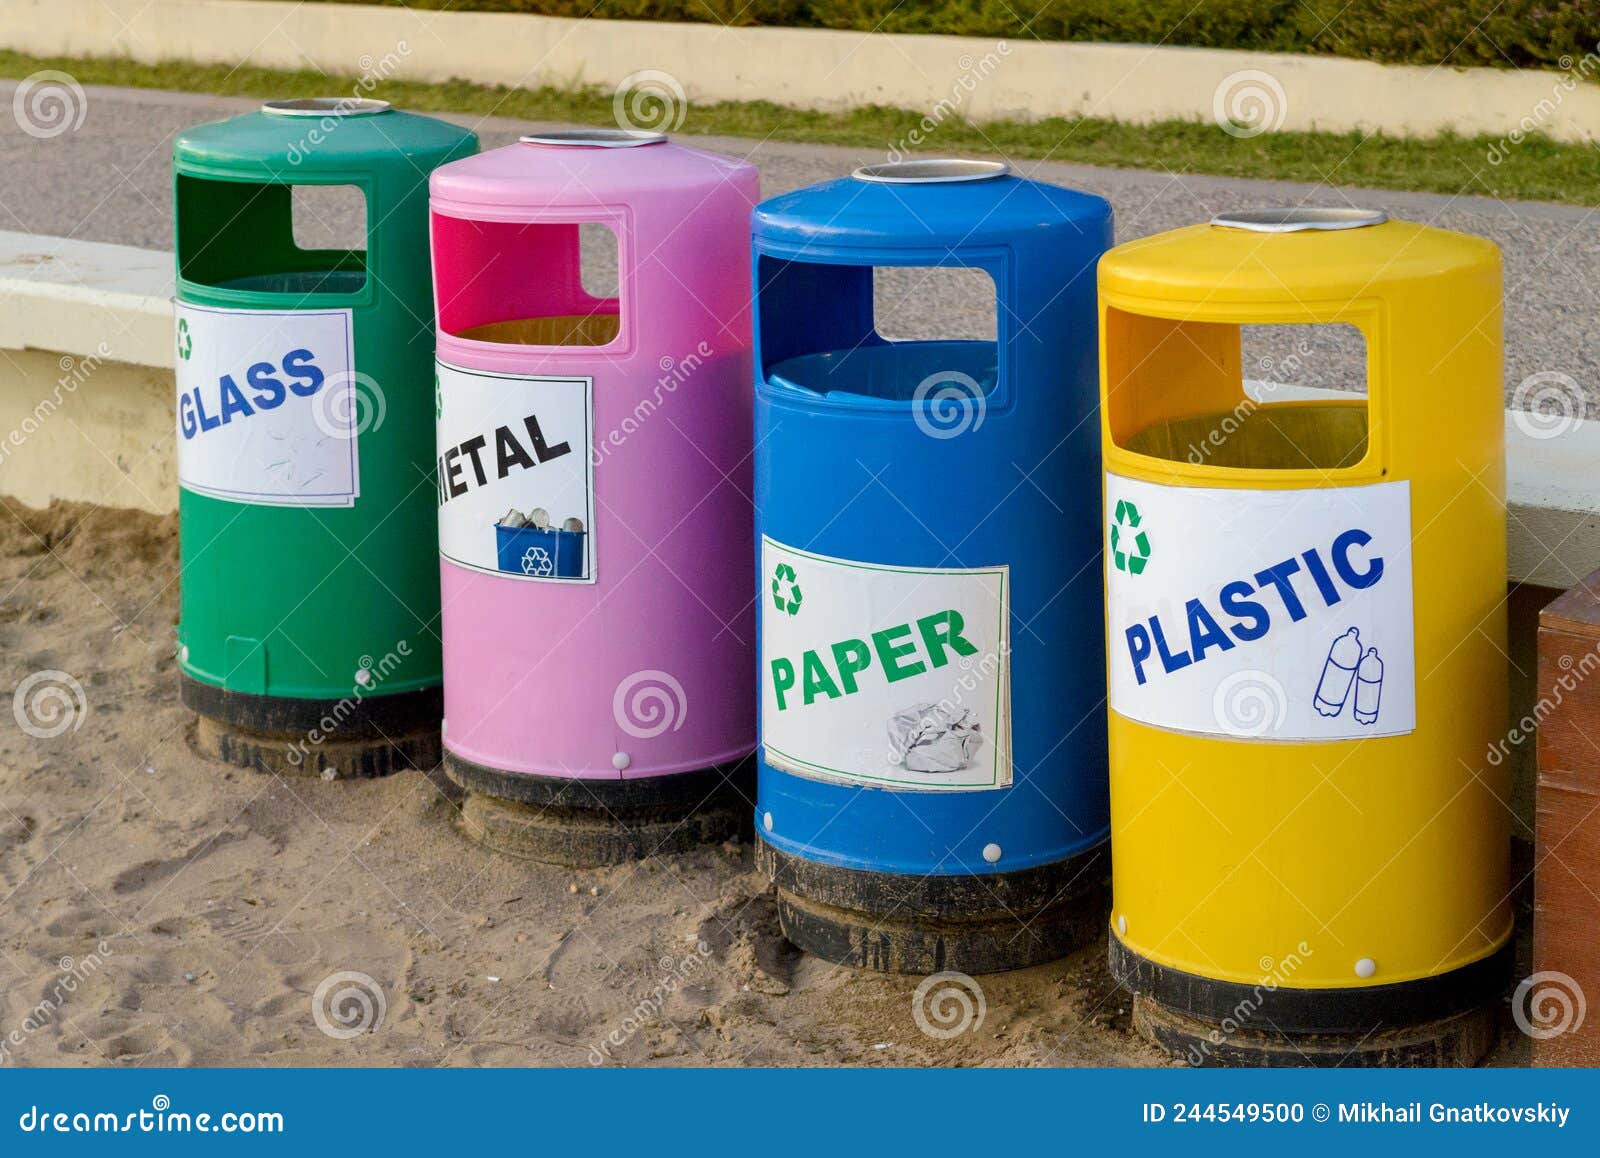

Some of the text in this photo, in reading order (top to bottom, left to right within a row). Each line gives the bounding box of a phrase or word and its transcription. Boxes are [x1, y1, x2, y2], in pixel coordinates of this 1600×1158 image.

[179, 348, 325, 440] GLASS
[1124, 528, 1385, 686] PLASTIC
[770, 609, 979, 711] PAPER
